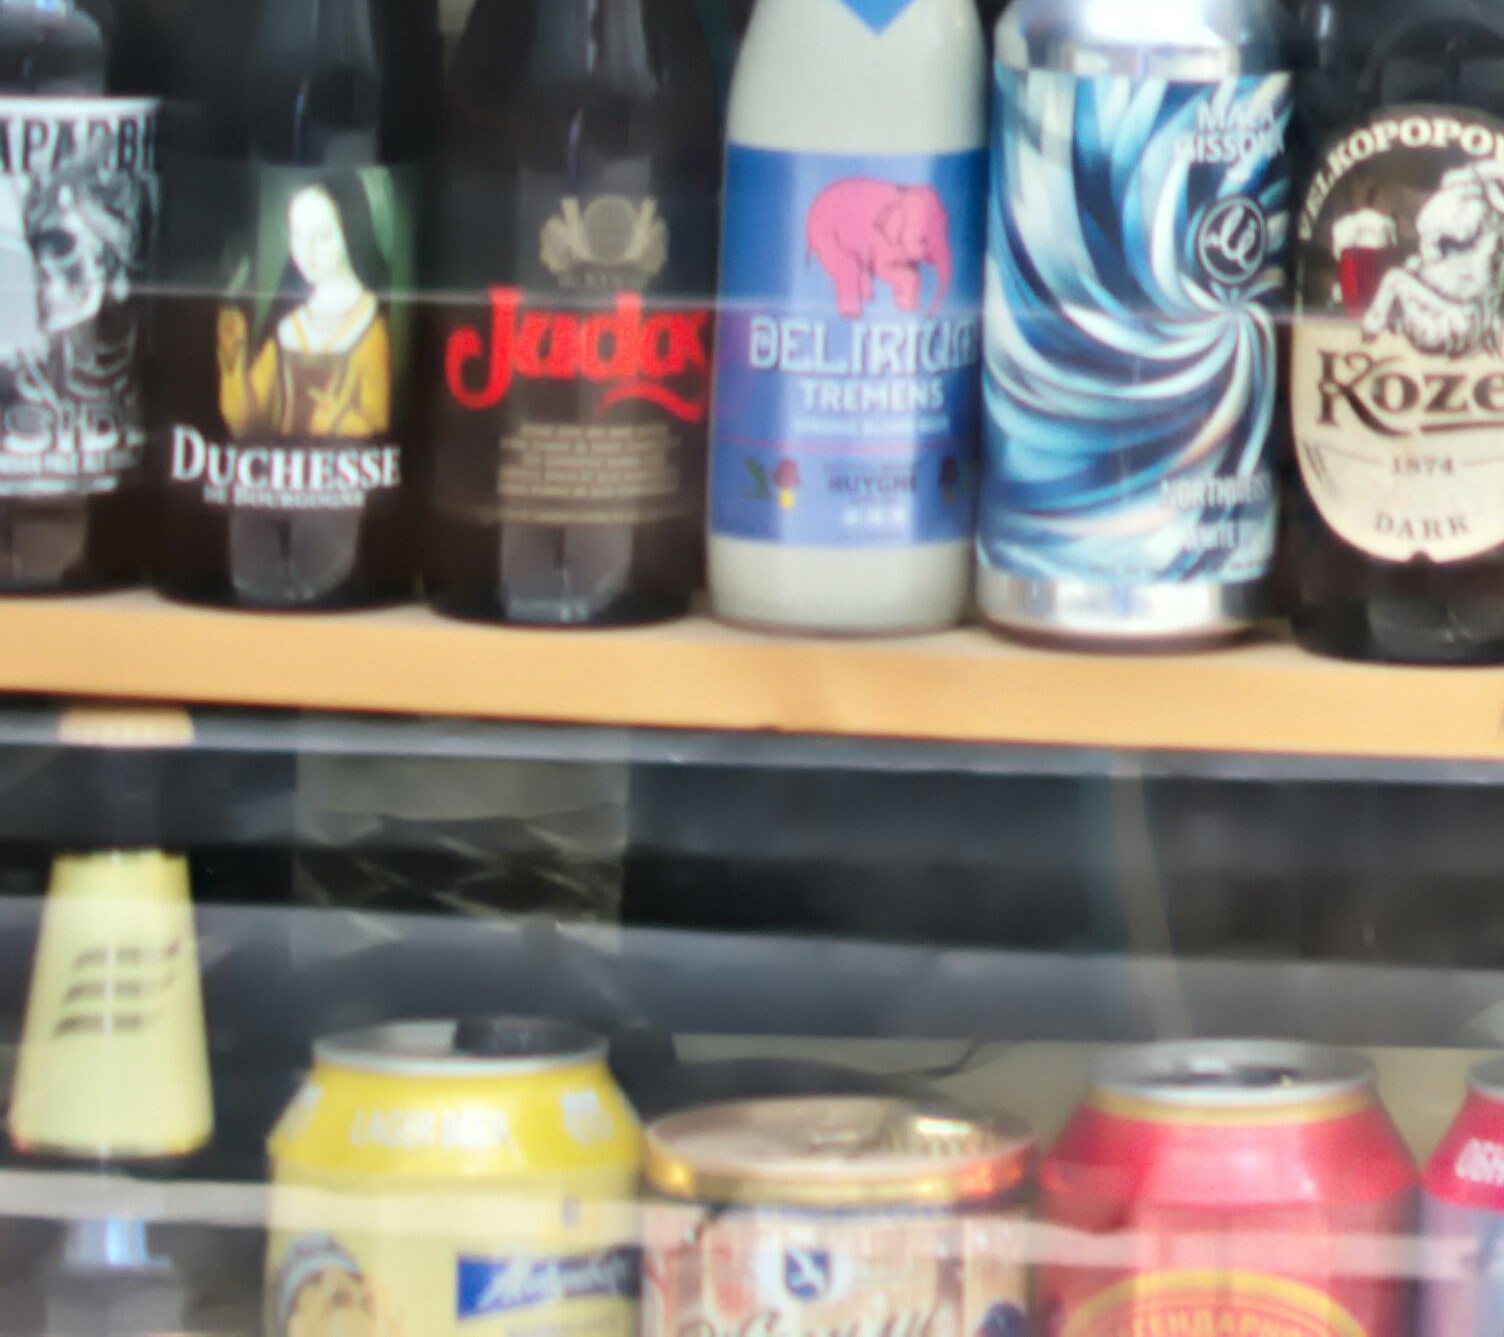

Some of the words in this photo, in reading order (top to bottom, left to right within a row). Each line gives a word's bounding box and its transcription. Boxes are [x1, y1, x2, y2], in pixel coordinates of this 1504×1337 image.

[444, 282, 710, 422] Judas
[800, 379, 945, 414] TREMENS
[170, 421, 402, 492] DUCHESSE
[1392, 455, 1456, 477] 1874
[1374, 511, 1472, 542] DARK
[351, 1105, 437, 1148] LAGER
